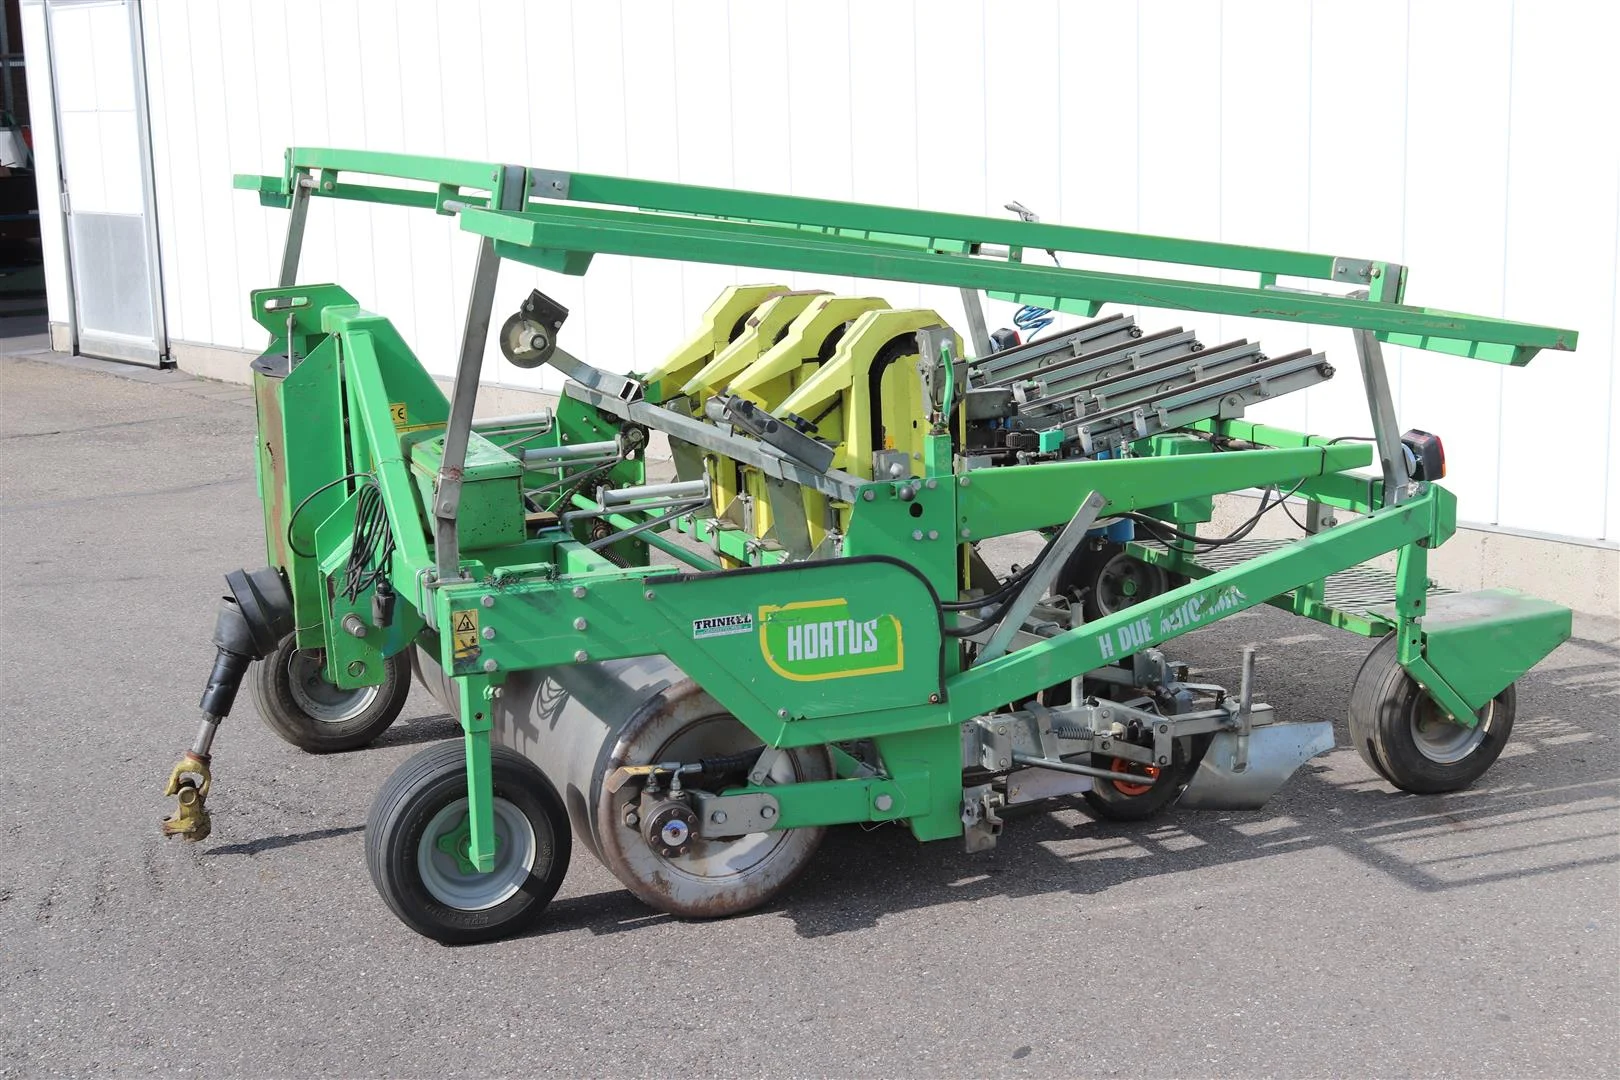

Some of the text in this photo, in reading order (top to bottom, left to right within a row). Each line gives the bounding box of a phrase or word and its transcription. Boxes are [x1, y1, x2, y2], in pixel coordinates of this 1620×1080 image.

[694, 615, 752, 630] TRINKEL
[787, 619, 878, 662] HORTUS
[1099, 632, 1114, 659] H
